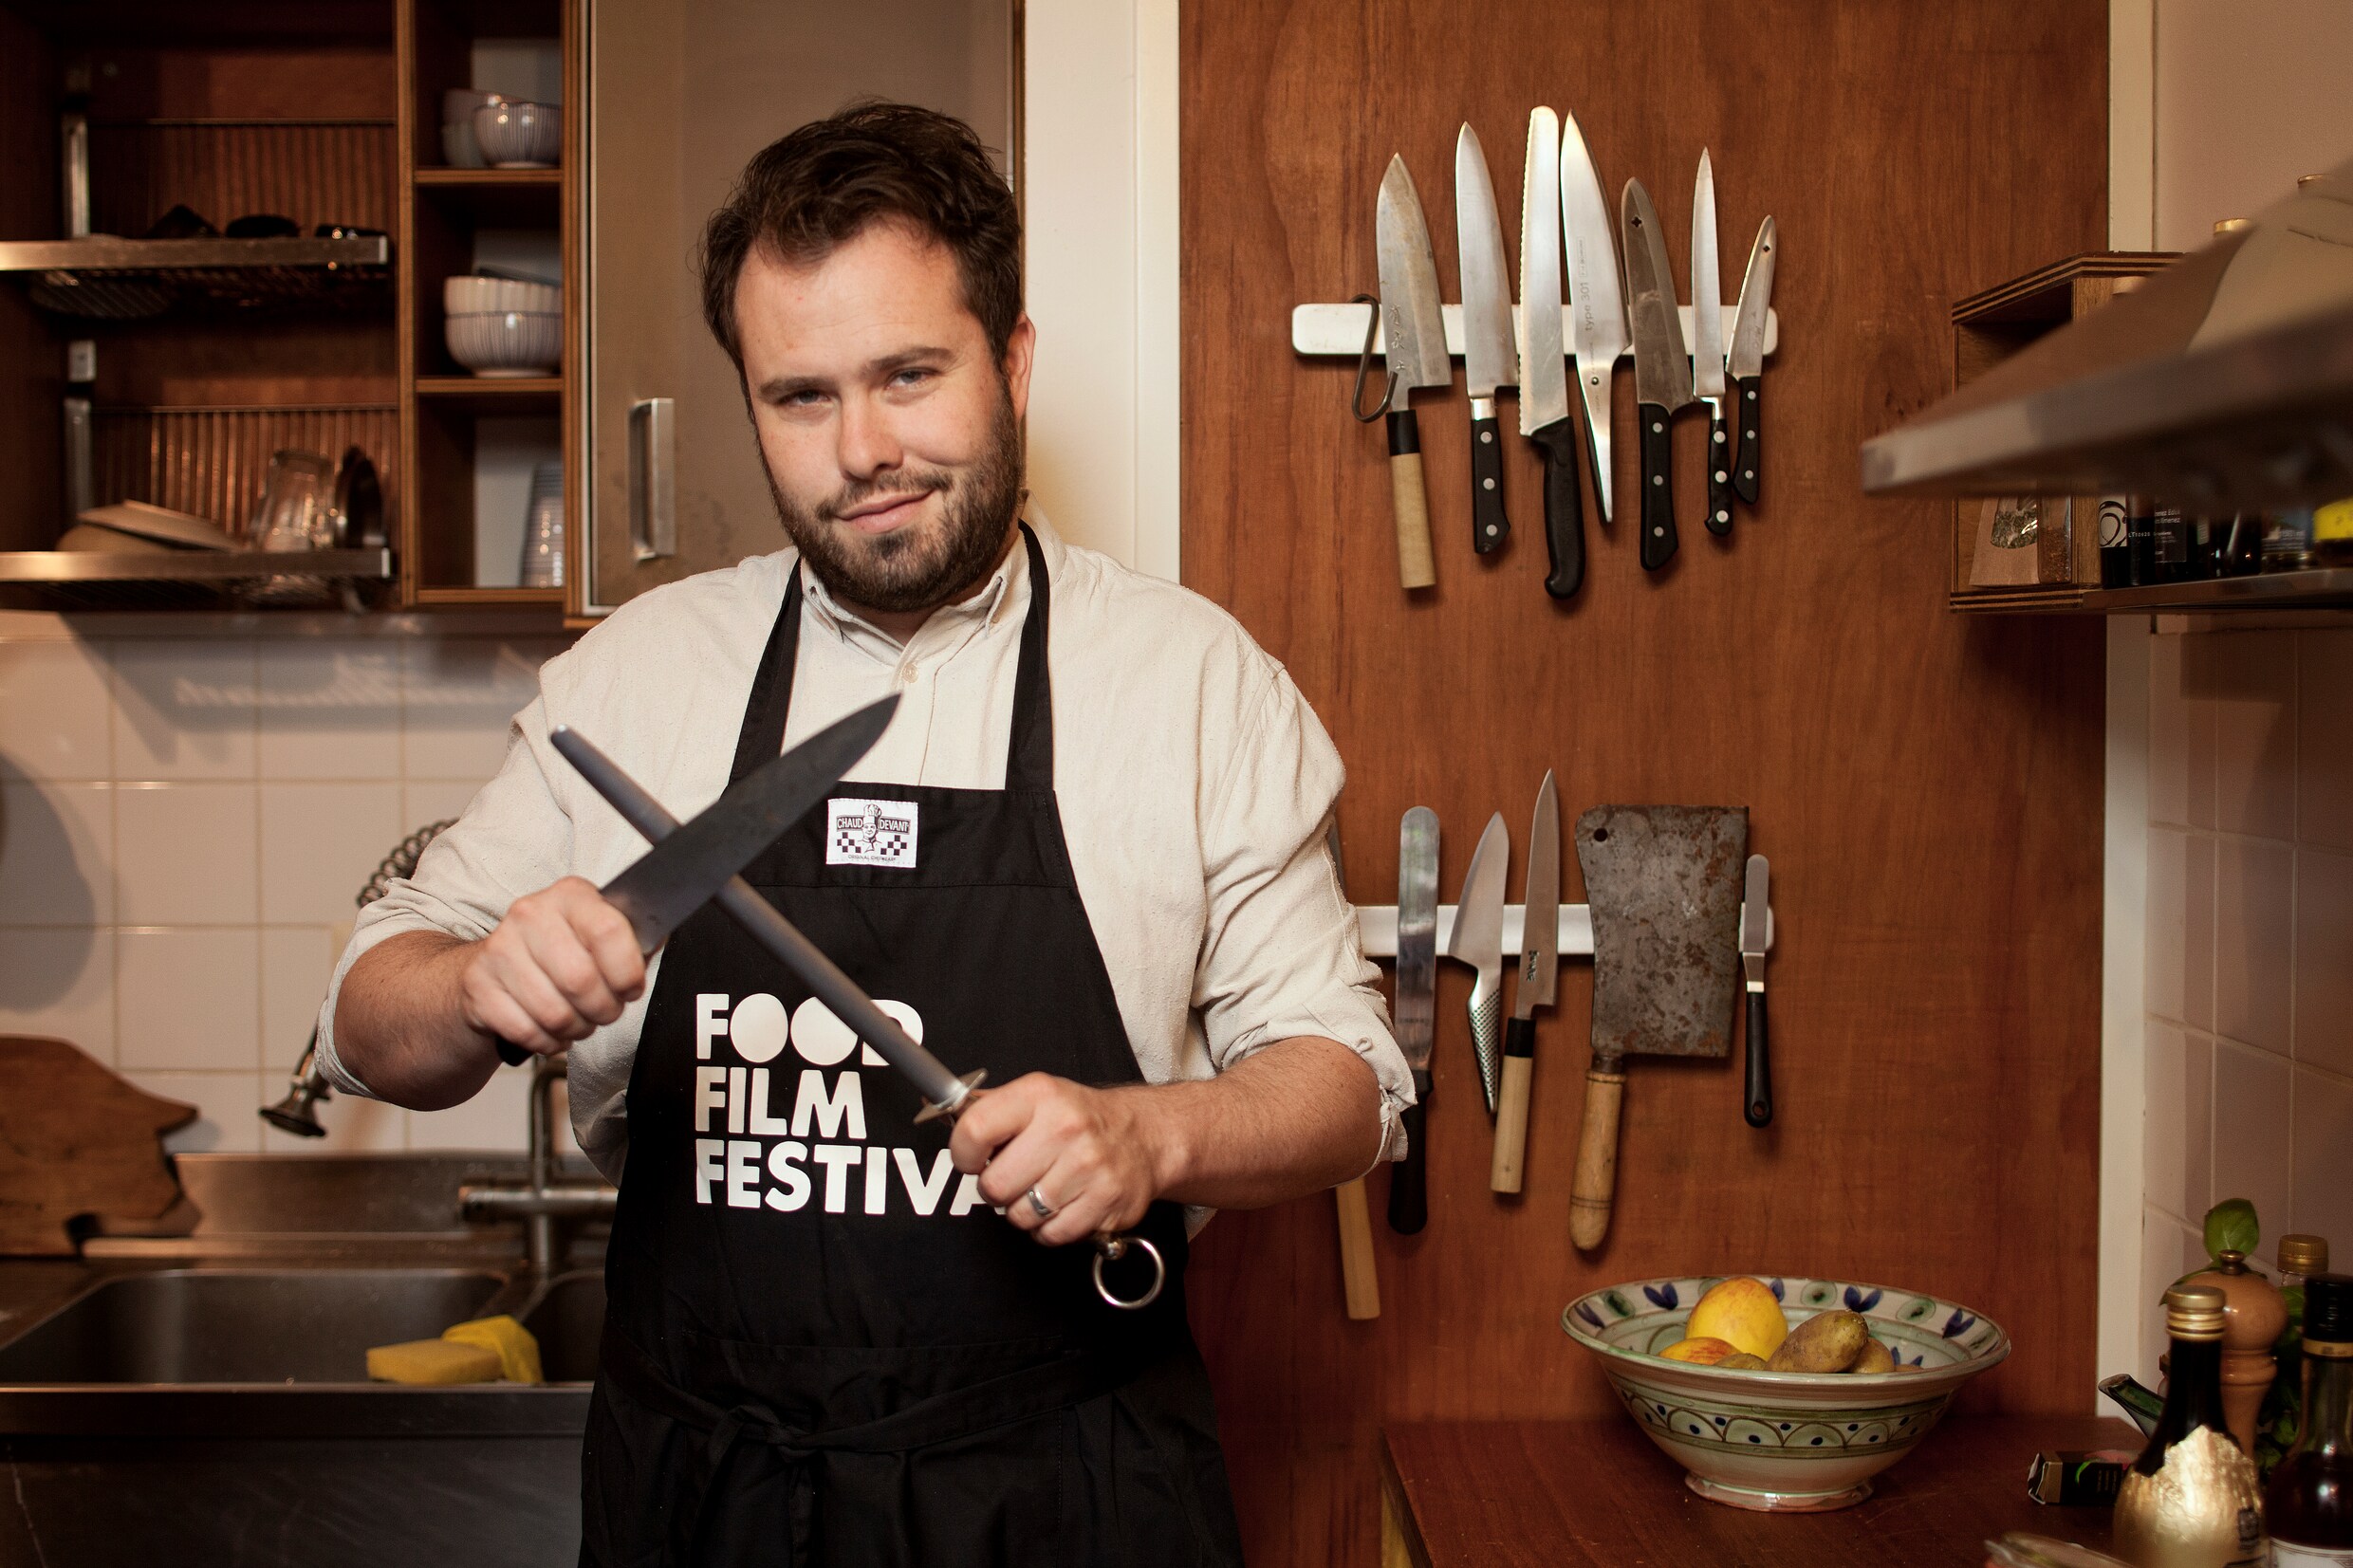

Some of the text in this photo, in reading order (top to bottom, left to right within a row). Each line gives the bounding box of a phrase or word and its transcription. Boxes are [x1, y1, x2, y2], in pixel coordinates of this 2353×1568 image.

[1580, 282, 1590, 302] 301
[1584, 304, 1595, 332] type
[837, 818, 909, 832] CHAUD DEVANT
[695, 1065, 867, 1139] FILM
[695, 1138, 1007, 1216] FESTIV
